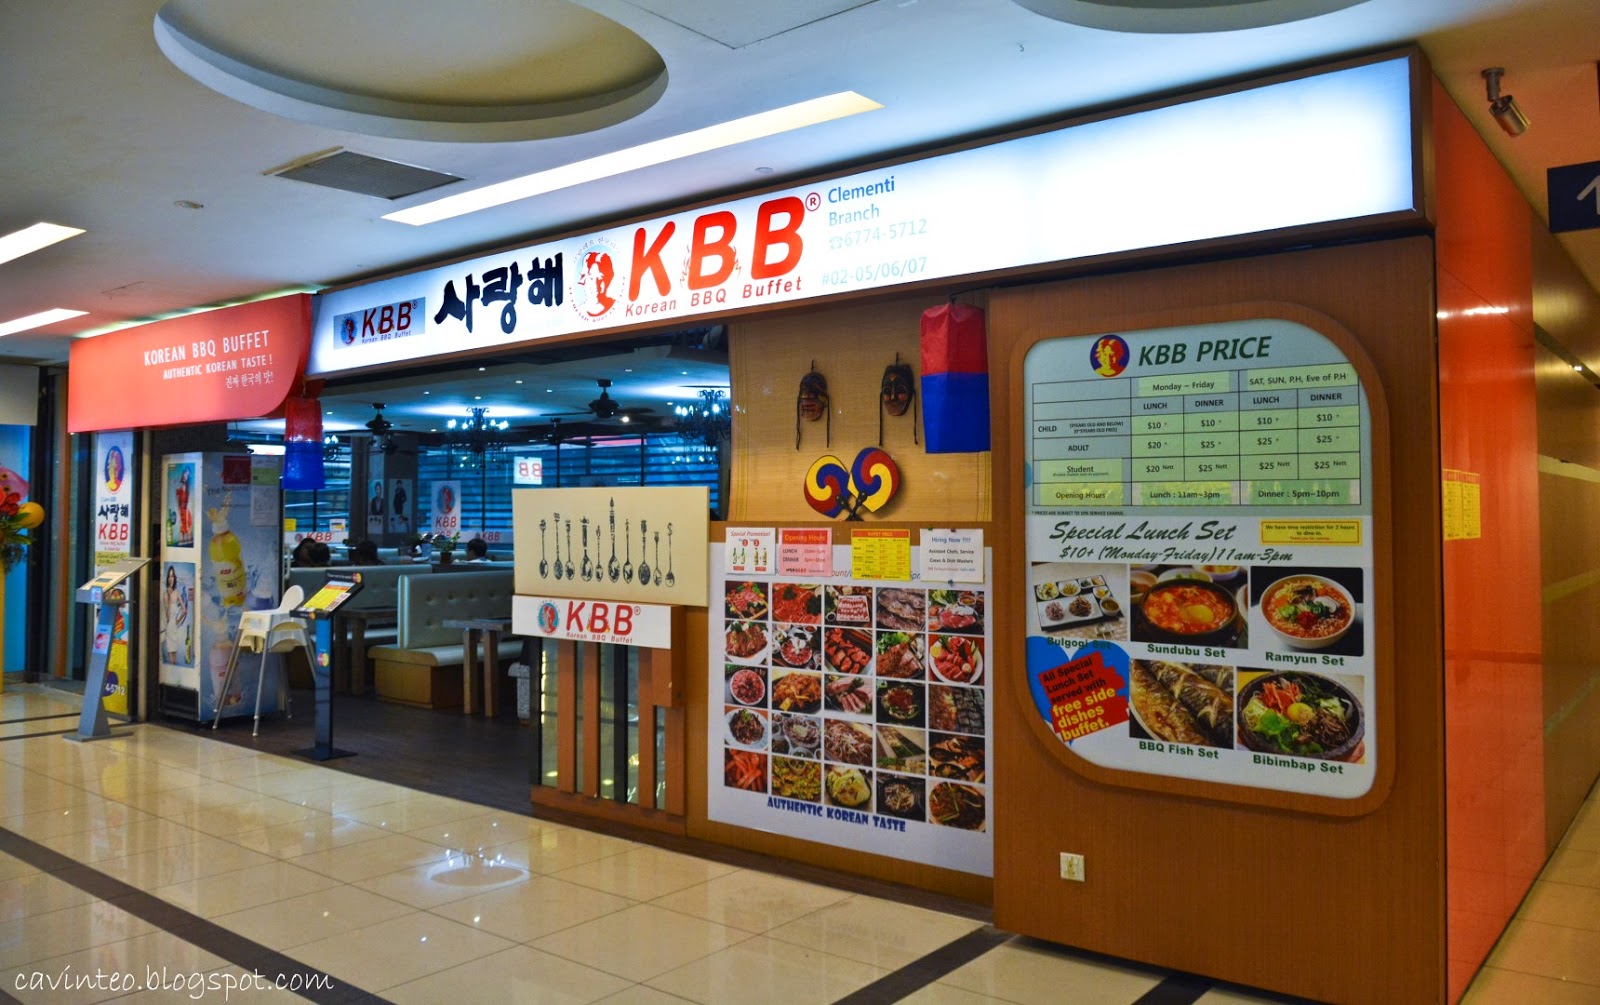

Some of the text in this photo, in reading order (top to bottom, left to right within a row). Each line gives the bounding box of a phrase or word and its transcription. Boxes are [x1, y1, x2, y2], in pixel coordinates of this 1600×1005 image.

[828, 176, 895, 204] Clementi
[829, 204, 880, 226] Branch
[844, 218, 928, 248] 6774-5712
[628, 196, 805, 301] KBB
[822, 256, 928, 286] #02-05/06/07
[434, 252, 564, 334] 사랑해
[625, 276, 802, 318] Korean BBQ Buffet
[362, 301, 412, 338] KBB
[144, 330, 269, 366] KOREAN BBQ BUFFET
[1138, 336, 1272, 366] KBB PRICE
[163, 364, 202, 380] AUTHENTIC
[206, 360, 237, 374] KOREAN
[241, 355, 266, 368] TASTE
[1152, 380, 1214, 392] Monday Friday
[1250, 378, 1265, 386] SAT,
[1268, 376, 1287, 385] SUN,
[1306, 374, 1320, 382] Eve
[1322, 373, 1331, 381] of
[1143, 393, 1342, 410] LUNCH DINNER LUNCH DINNER
[1148, 414, 1332, 430] $10 $10 $10 $10
[1148, 435, 1332, 450] $20 $25 $25 $25
[1066, 466, 1094, 474] Student
[1146, 466, 1160, 474] $20
[1198, 464, 1212, 472] $25
[1260, 462, 1274, 470] $25
[1314, 461, 1330, 470] $25
[1056, 492, 1084, 500] Opening
[1258, 490, 1284, 498] Dinner
[98, 504, 129, 522] 사랑해
[435, 516, 457, 528] KBB
[98, 523, 129, 540] KBB
[784, 534, 808, 542] Opening
[1049, 520, 1236, 543] Special Lunch Set
[1059, 545, 1094, 559] $10+
[566, 600, 633, 636] KBB
[566, 632, 632, 644] Korean BBQ Buffet
[1047, 637, 1112, 650] Bulgogi Set
[1147, 644, 1226, 658] Sundubu Set
[1265, 652, 1344, 666] Ramyun Set
[1043, 656, 1093, 683] All Special
[1046, 670, 1094, 694] Lunch Set
[1051, 678, 1106, 704] served with
[1052, 687, 1116, 718] free side
[1058, 706, 1105, 729] dishes
[1060, 718, 1110, 742] buffet.
[1139, 740, 1219, 759] BBQ Fish Set
[1253, 754, 1344, 774] Bibimbap Set
[767, 796, 906, 832] AUTHENTIC KOREAN TASTE
